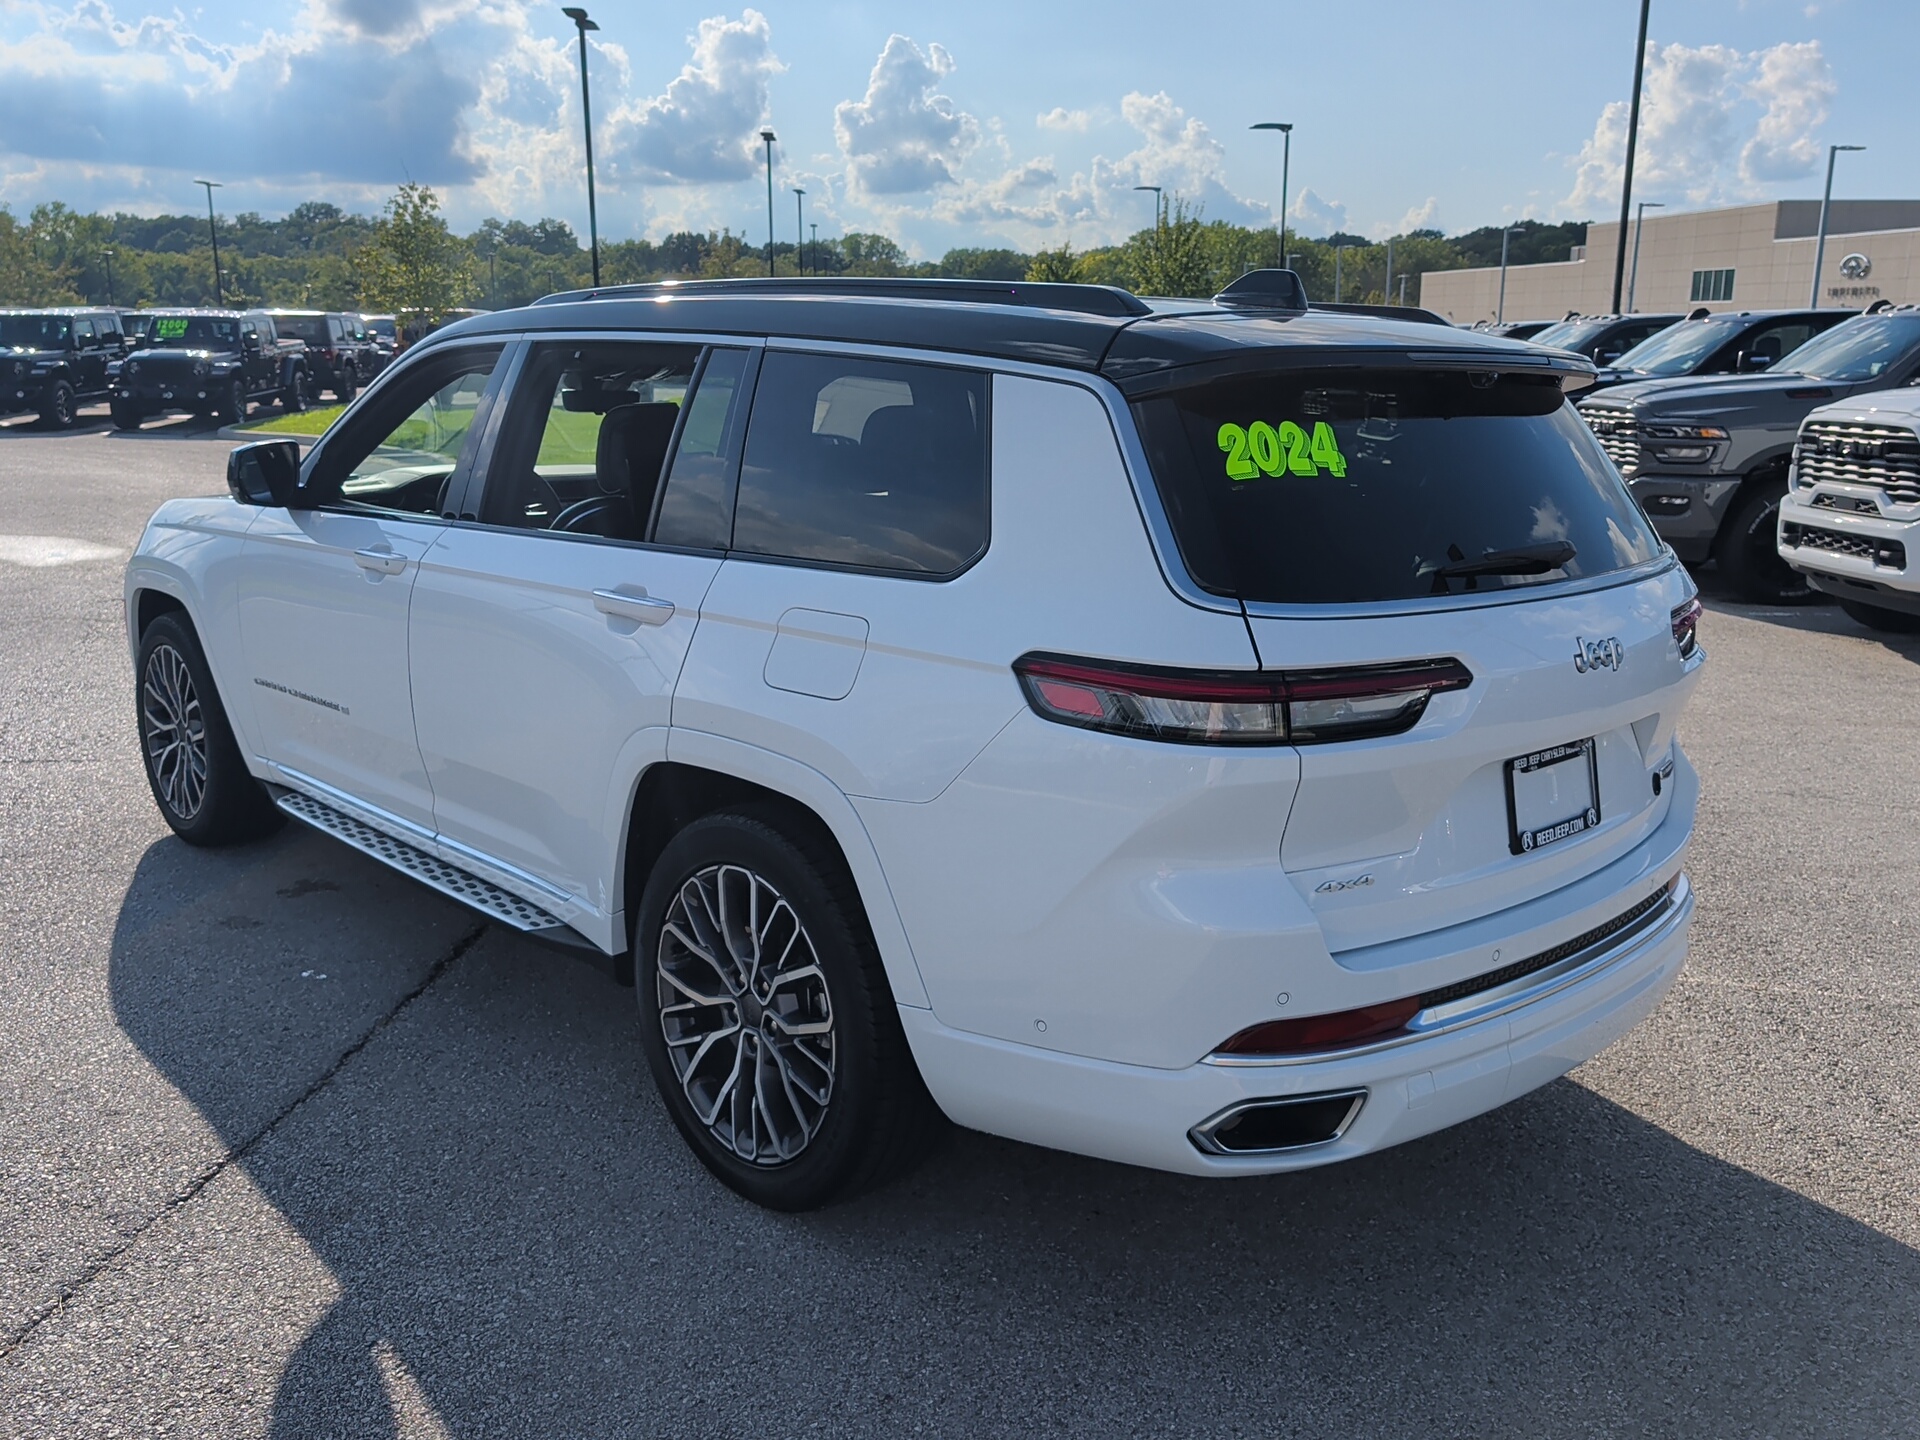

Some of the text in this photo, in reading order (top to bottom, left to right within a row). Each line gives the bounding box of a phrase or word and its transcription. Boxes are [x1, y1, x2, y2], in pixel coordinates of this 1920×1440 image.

[1217, 420, 1347, 480] 2024
[1573, 636, 1624, 673] Jeep
[1514, 757, 1527, 770] REED
[1528, 753, 1540, 766] JEEP
[1541, 746, 1566, 762] CHRYSLER
[1536, 817, 1584, 846] REEDJEEP.COM
[1315, 873, 1375, 893] 4x4
